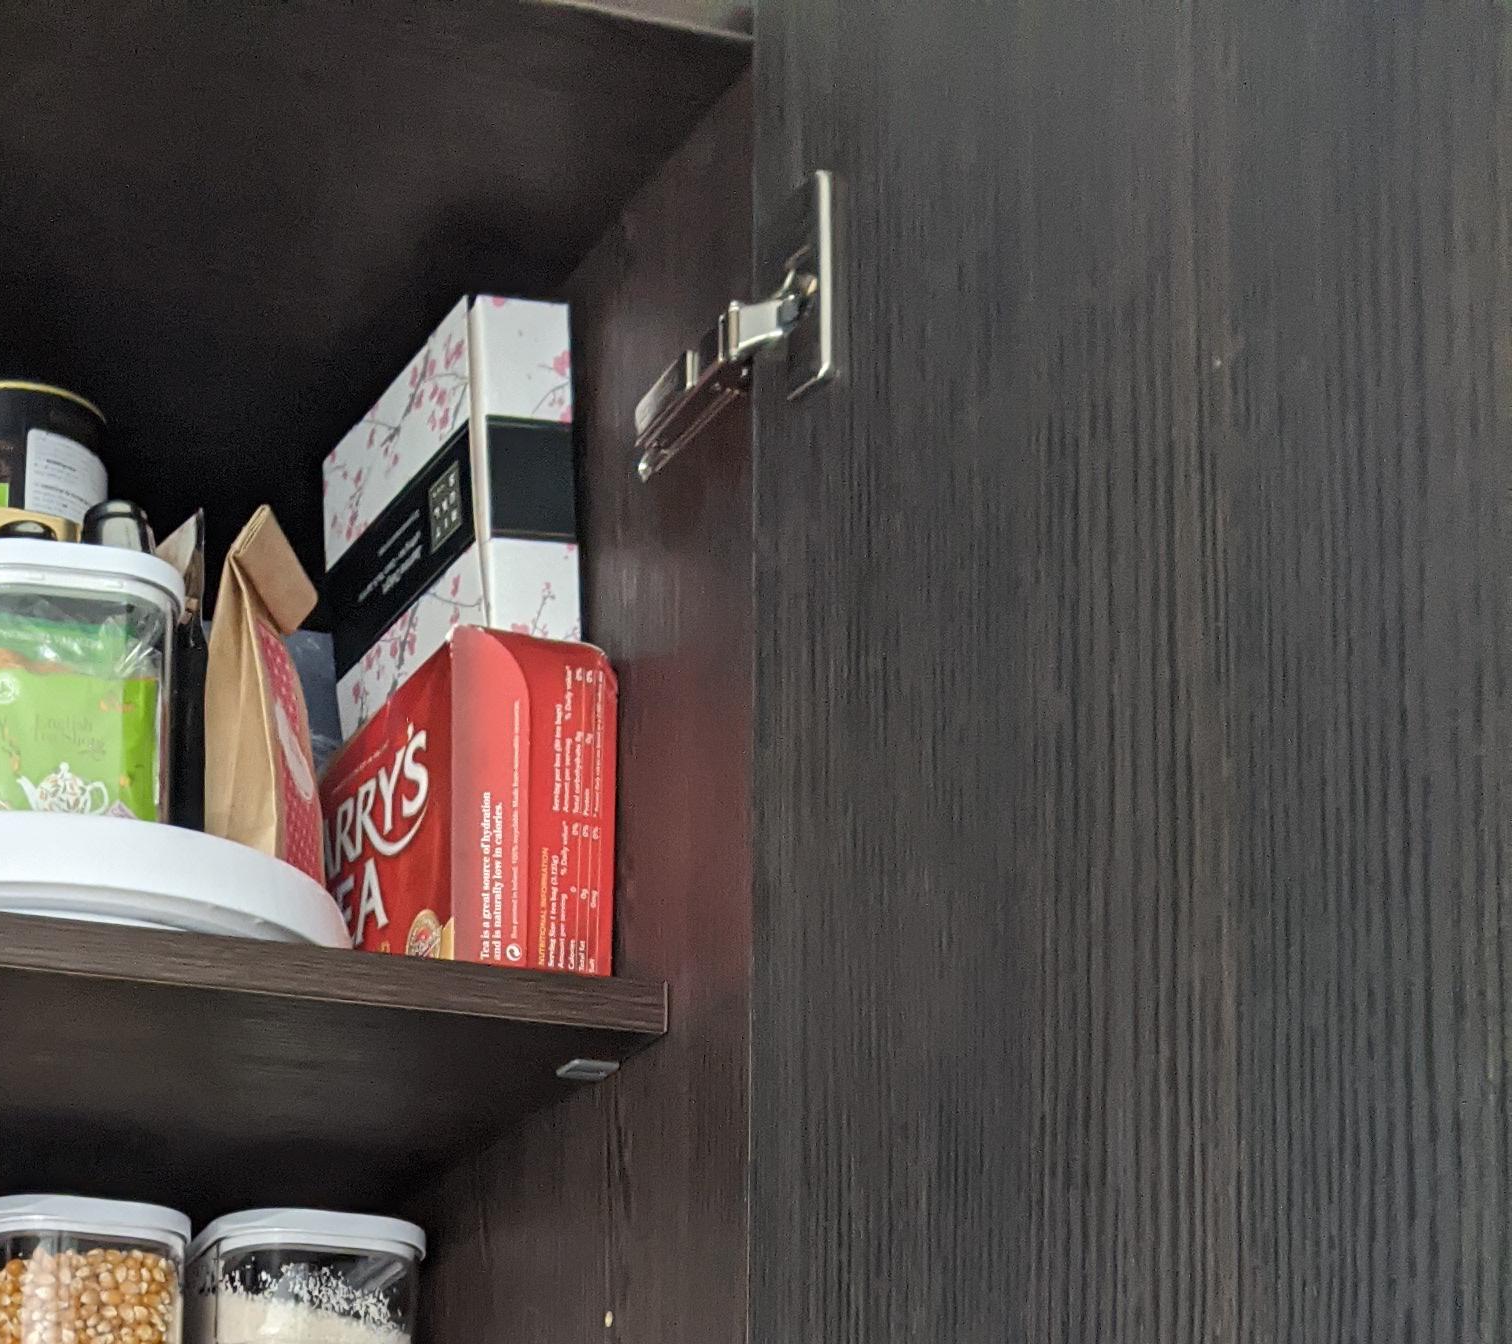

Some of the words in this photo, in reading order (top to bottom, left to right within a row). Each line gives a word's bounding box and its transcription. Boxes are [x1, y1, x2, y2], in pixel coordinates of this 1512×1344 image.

[323, 721, 429, 880] RRY'S
[481, 792, 492, 842] hydration
[493, 802, 503, 845] calories.
[480, 843, 490, 854] of
[493, 847, 502, 857] in
[481, 857, 490, 890] source
[493, 860, 502, 879] low
[540, 848, 548, 909] INFORMATION
[334, 857, 389, 946] EA
[481, 893, 492, 920] great
[493, 882, 504, 927] naturally
[480, 930, 490, 938] is
[493, 930, 502, 938] is
[539, 910, 547, 965] NUTRITIONAL
[480, 941, 490, 960] Tea
[493, 941, 502, 960] and
